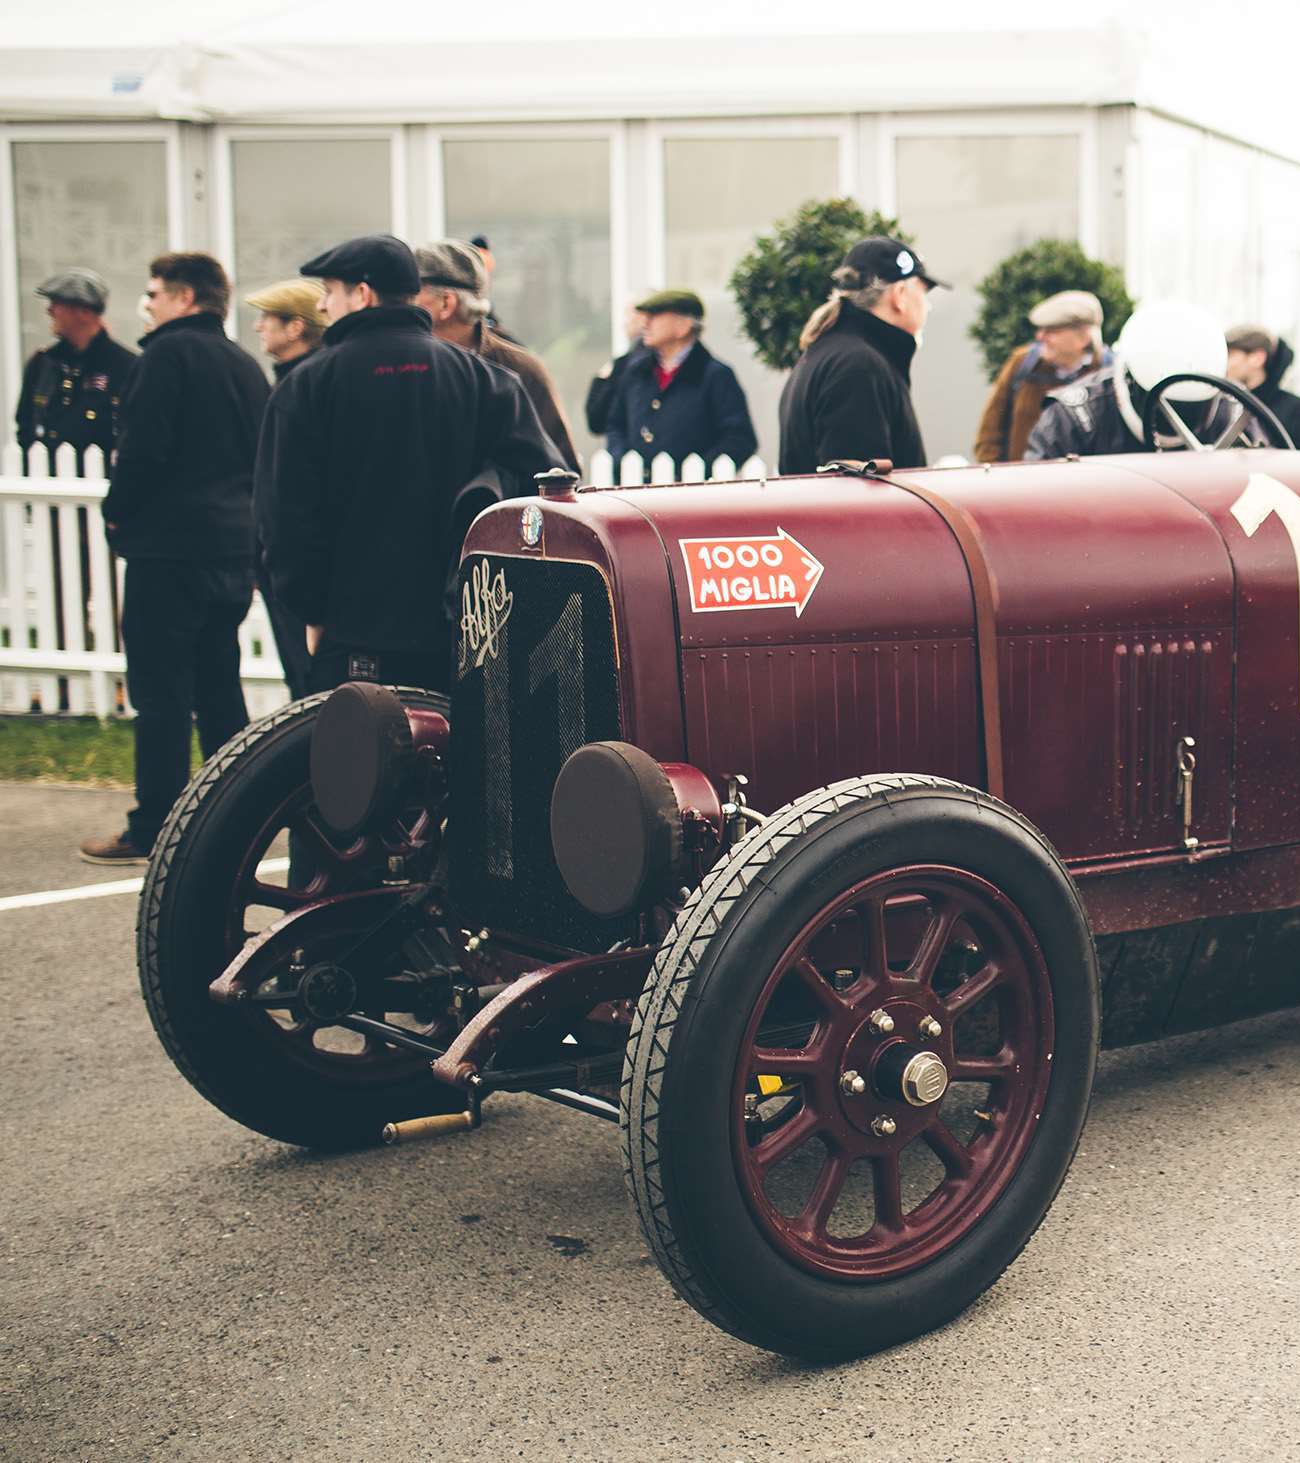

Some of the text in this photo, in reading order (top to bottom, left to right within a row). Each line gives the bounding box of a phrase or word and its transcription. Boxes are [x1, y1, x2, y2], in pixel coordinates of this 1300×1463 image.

[698, 544, 784, 571] 1000
[701, 574, 797, 604] MIGLIA
[458, 558, 514, 670] Alfa
